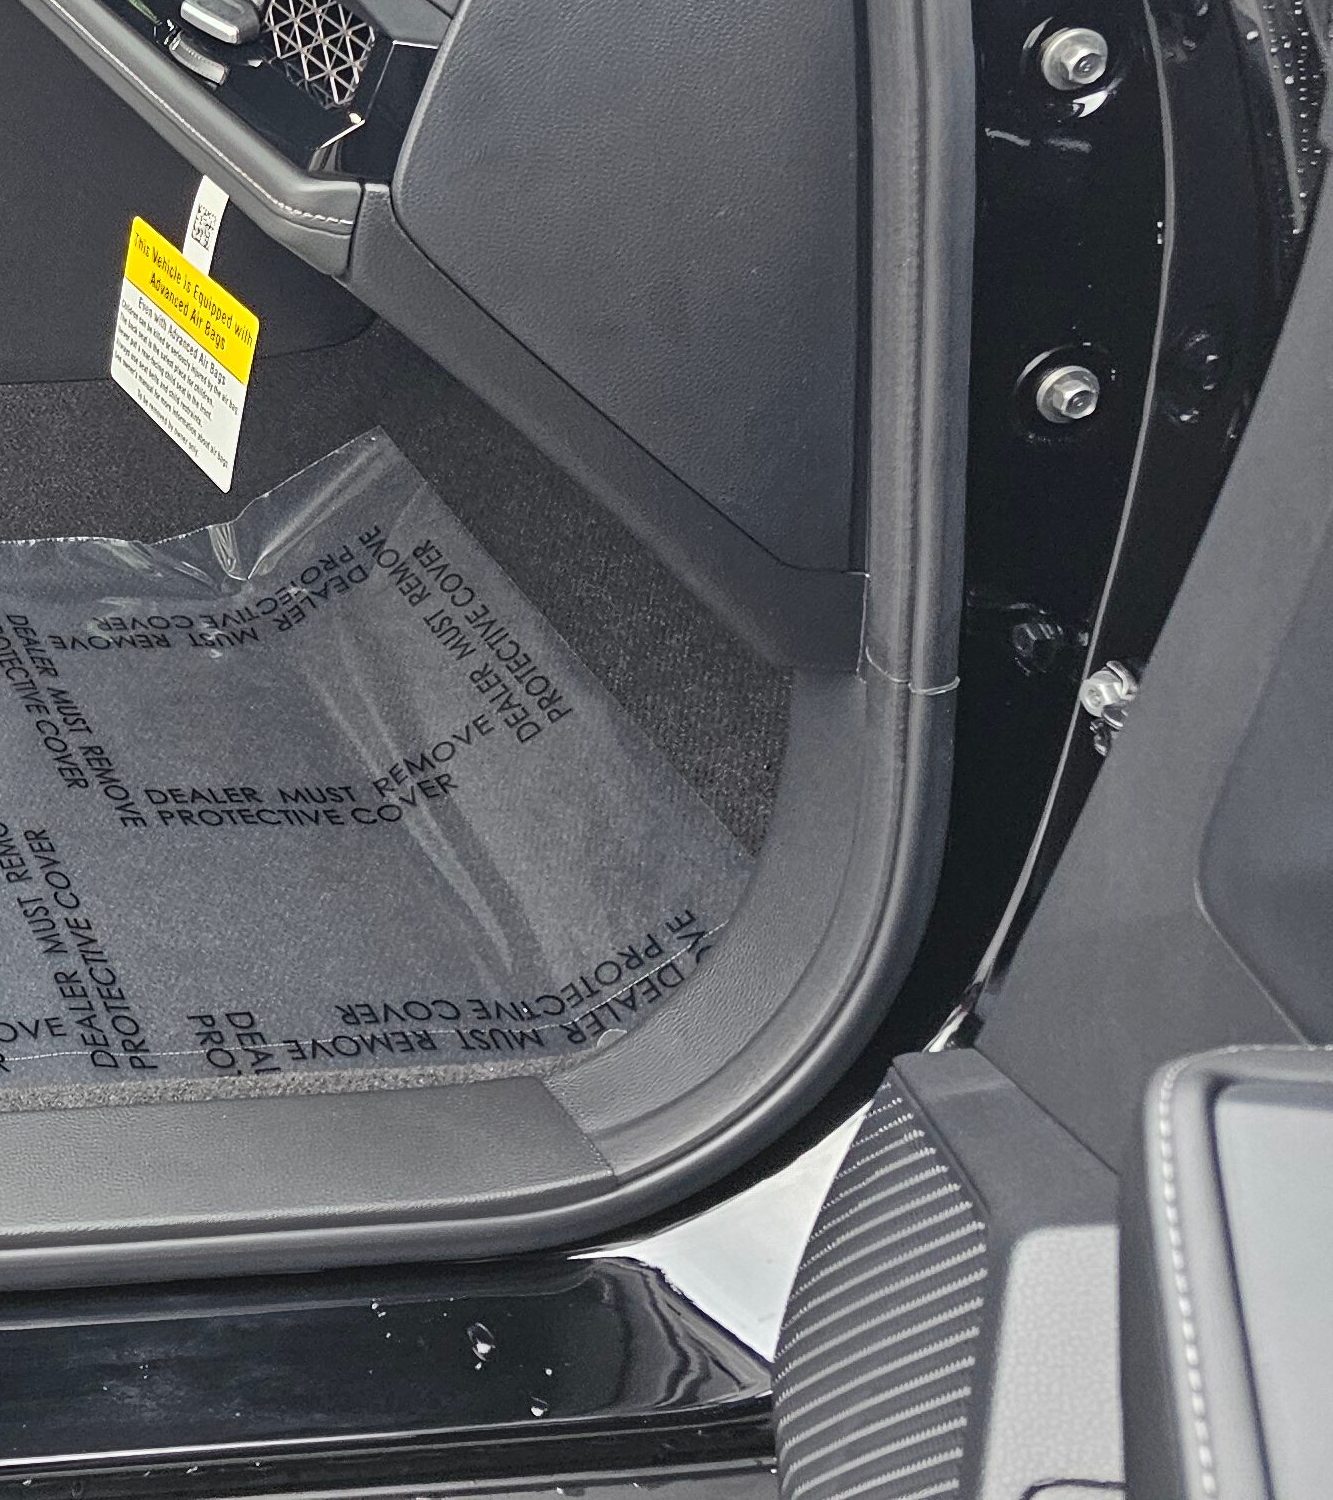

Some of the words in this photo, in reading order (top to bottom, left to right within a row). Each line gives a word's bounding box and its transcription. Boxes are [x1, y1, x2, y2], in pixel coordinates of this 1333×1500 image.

[134, 232, 149, 257] This
[152, 246, 182, 285] Vehicle
[184, 274, 192, 294] is
[193, 285, 234, 330] Equipped
[235, 322, 253, 348] with
[150, 272, 189, 317] Advanced
[190, 308, 204, 329] Air
[204, 320, 226, 351] Bags
[138, 296, 153, 318] Even
[154, 312, 167, 331] with
[168, 324, 199, 360] Advanced
[198, 352, 209, 370] Air
[199, 544, 355, 629] PROTECTIVE
[271, 563, 369, 633] DEALER
[358, 525, 432, 607] REMOVE
[412, 539, 476, 607] COVER
[51, 634, 171, 650] REMOVE
[93, 615, 194, 632] COVER
[188, 627, 260, 648] MUST
[422, 608, 477, 661] MUST
[464, 604, 573, 724] PROTECTIVE
[4, 612, 59, 678] DEALER
[47, 686, 92, 734] MUST
[79, 745, 147, 828] REMOVE
[469, 662, 541, 743] DEALER
[36, 719, 89, 789] COVER
[144, 787, 259, 806] DEALER
[278, 785, 357, 805] MUST
[372, 714, 495, 798] REMOVE
[156, 807, 345, 828] PROTECTIVE
[351, 771, 459, 824] COVER
[24, 829, 80, 910] COVER
[17, 896, 68, 954] MUST
[65, 917, 158, 1070] PROTECTIVE
[335, 1000, 461, 1026] COVER
[473, 934, 664, 1022] PROTECTIVE
[560, 962, 685, 1044] DEALER
[54, 970, 120, 1069] DEALER
[283, 1030, 438, 1061] REMOVE
[455, 1028, 546, 1050] MUST
